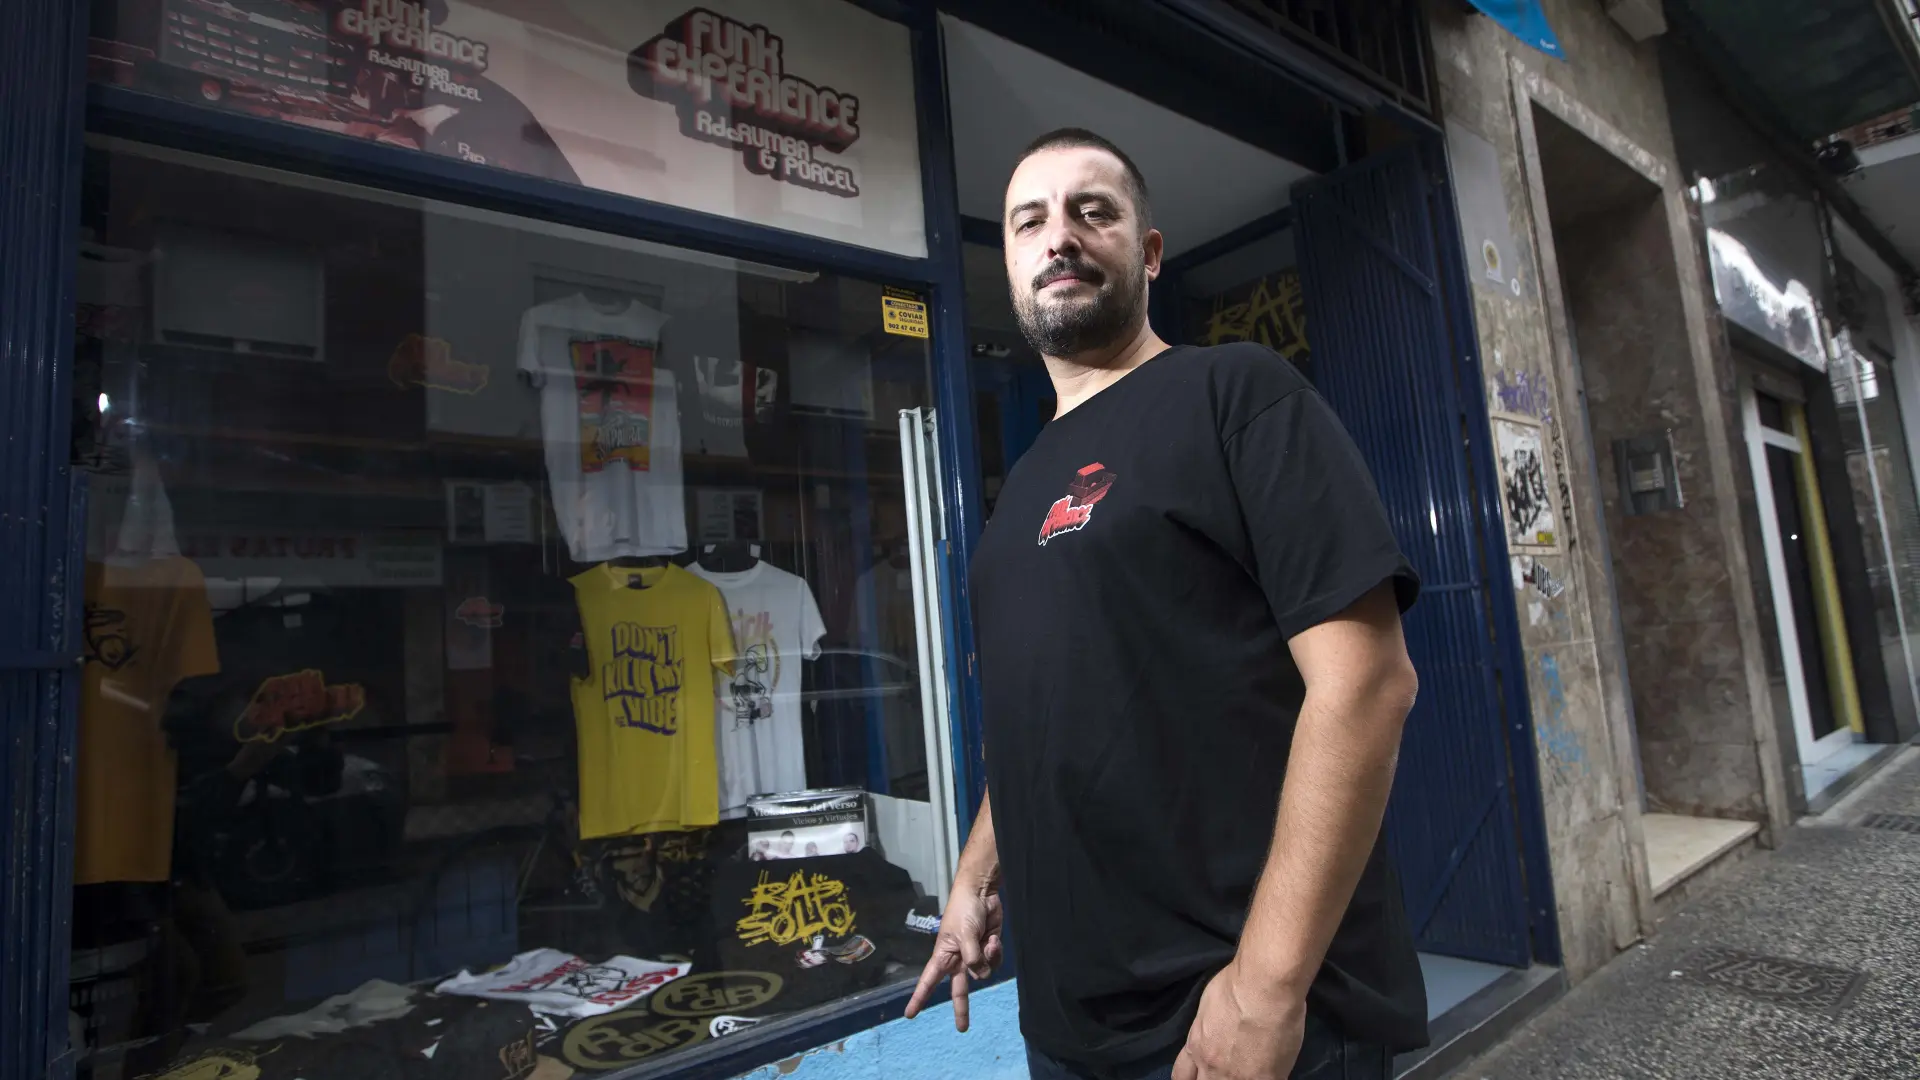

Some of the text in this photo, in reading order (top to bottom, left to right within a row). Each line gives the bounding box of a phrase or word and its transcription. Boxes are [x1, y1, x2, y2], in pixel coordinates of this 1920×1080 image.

[366, 0, 430, 34] FUNK
[342, 8, 488, 70] EXPERIENCE
[691, 10, 780, 77] FUNK
[429, 78, 483, 103] PORCEL
[656, 37, 859, 135] EXPERIENCE
[760, 148, 857, 193] & PORCEL
[898, 311, 923, 321] COVIAR
[611, 620, 678, 665] DON'T
[650, 656, 685, 695] MY
[621, 695, 677, 736] VIBE
[810, 801, 827, 813] del
[829, 799, 858, 811] Verso
[825, 812, 858, 823] Virtudes
